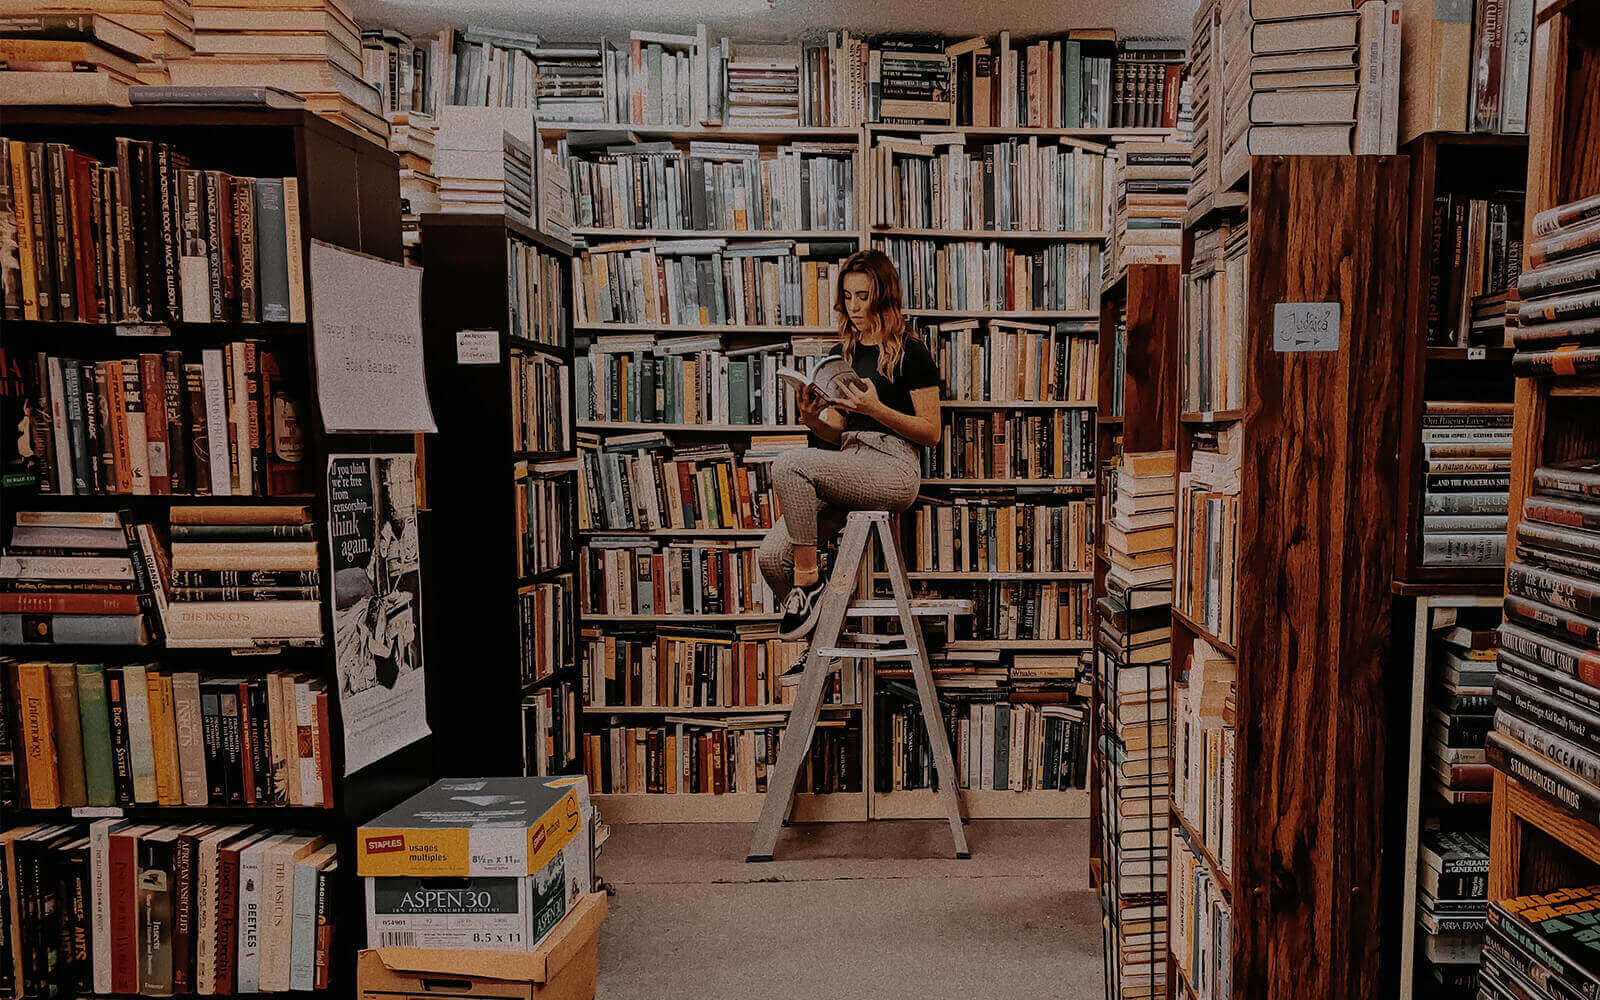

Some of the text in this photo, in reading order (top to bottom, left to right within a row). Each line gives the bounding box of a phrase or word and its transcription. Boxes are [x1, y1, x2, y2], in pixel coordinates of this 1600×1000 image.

[160, 166, 170, 210] BLACKSTONE
[188, 175, 196, 200] Jerome
[162, 212, 170, 230] BOOK
[189, 202, 198, 230] Robbins
[163, 232, 170, 244] OF
[208, 186, 222, 315] DANCE JAMAICA REX NETTLEFORD
[165, 245, 174, 268] MAGIC
[247, 380, 258, 394] AND
[86, 392, 97, 440] LEARN MAGIC
[337, 466, 350, 478] you
[350, 462, 367, 474] think
[350, 474, 362, 486] free
[332, 488, 348, 500] from
[1462, 479, 1494, 487] POLICEMAN
[331, 512, 360, 537] think
[341, 538, 370, 562] again.
[145, 555, 160, 590] IGUANAS
[1525, 573, 1536, 585] THE
[1566, 584, 1574, 595] OF
[113, 707, 122, 726] BUGS
[1515, 695, 1586, 736] Does Foreign Aid Really Work?
[28, 697, 44, 760] Entomology
[115, 748, 127, 777] SYSTEM
[1510, 757, 1580, 810] STANDARDIZED MINDS
[368, 840, 402, 850] STAPLES
[409, 854, 447, 862] multiples
[180, 840, 190, 934] AFRICAN INSECT LIFE
[274, 863, 284, 927] THE INSECTS
[400, 891, 491, 908] ASPEN 30
[220, 862, 235, 980] Insects in Perspective
[247, 904, 257, 948] BEETLES
[75, 927, 87, 960] ANTS
[152, 921, 161, 950] Insects
[473, 933, 492, 942] 8.5
[509, 933, 520, 942] 11
